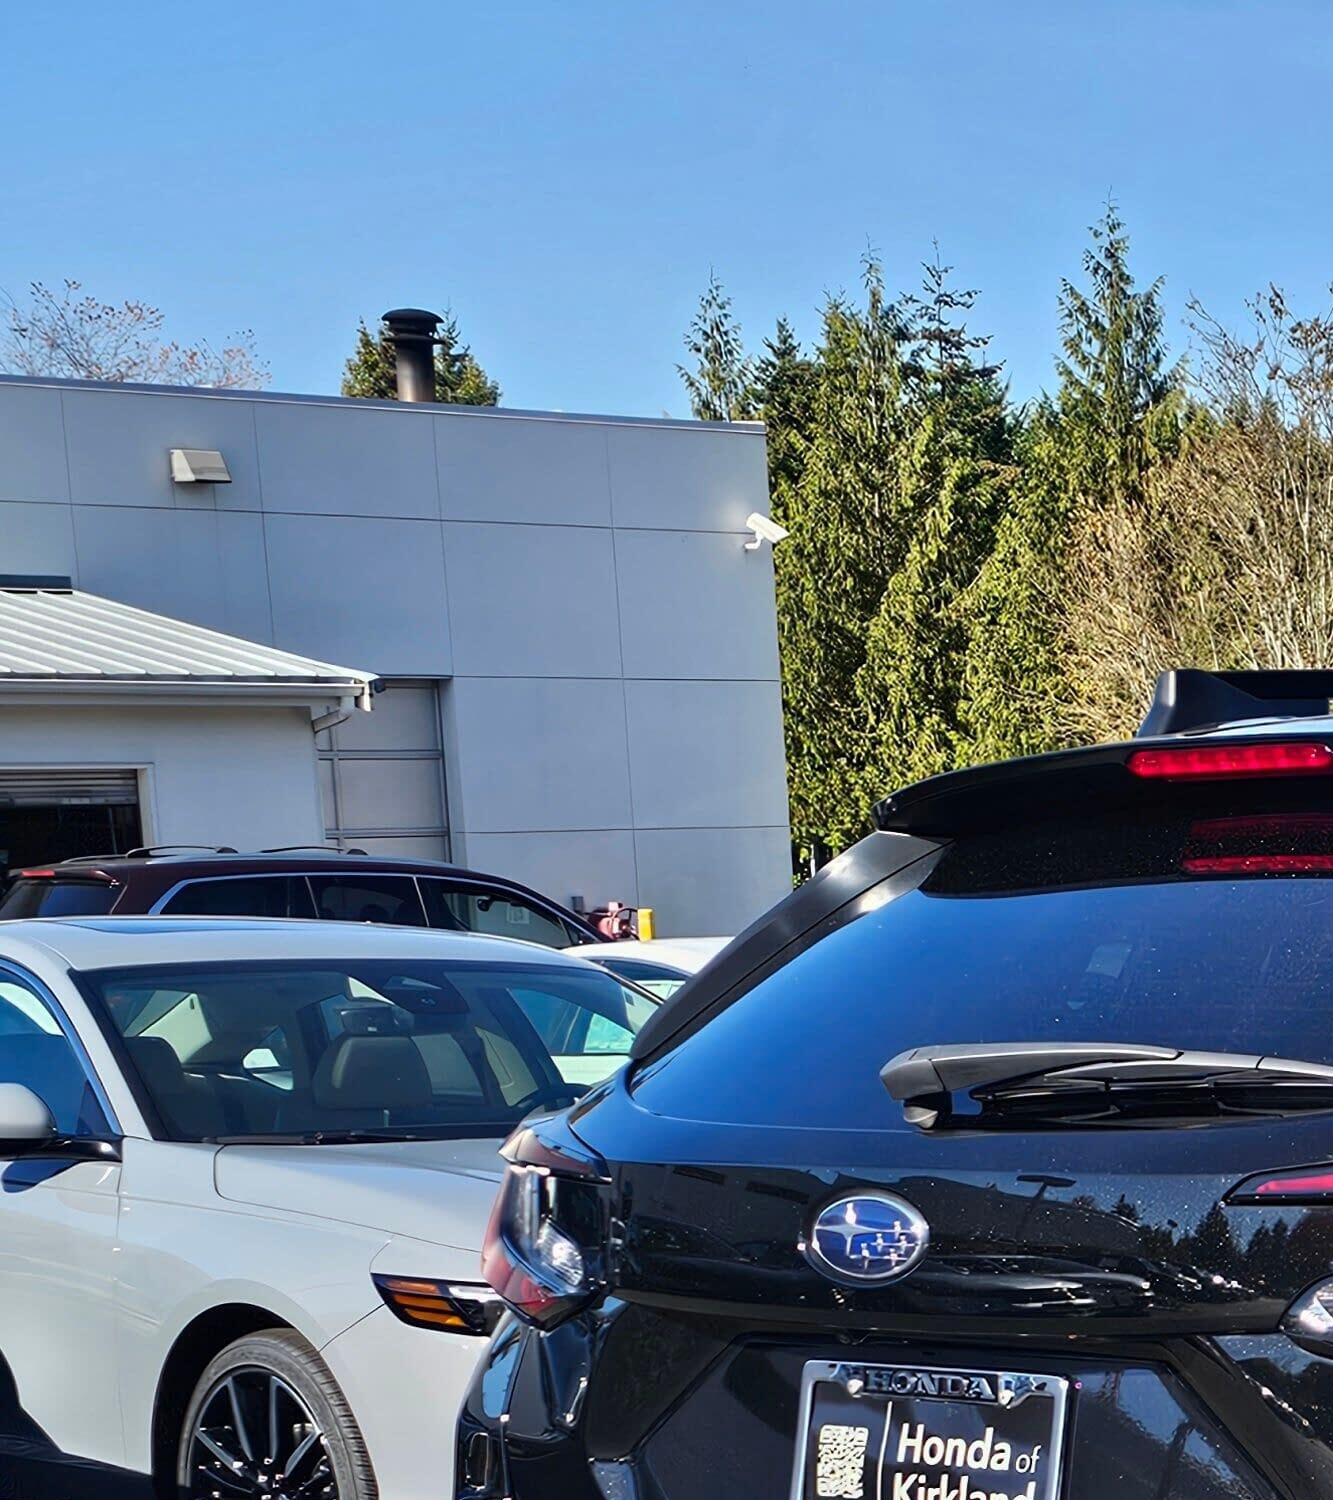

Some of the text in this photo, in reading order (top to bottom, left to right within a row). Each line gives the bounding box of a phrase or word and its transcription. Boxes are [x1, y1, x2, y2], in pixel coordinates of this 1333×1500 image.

[866, 1369, 996, 1399] HONDA
[896, 1422, 1042, 1474] Honda of
